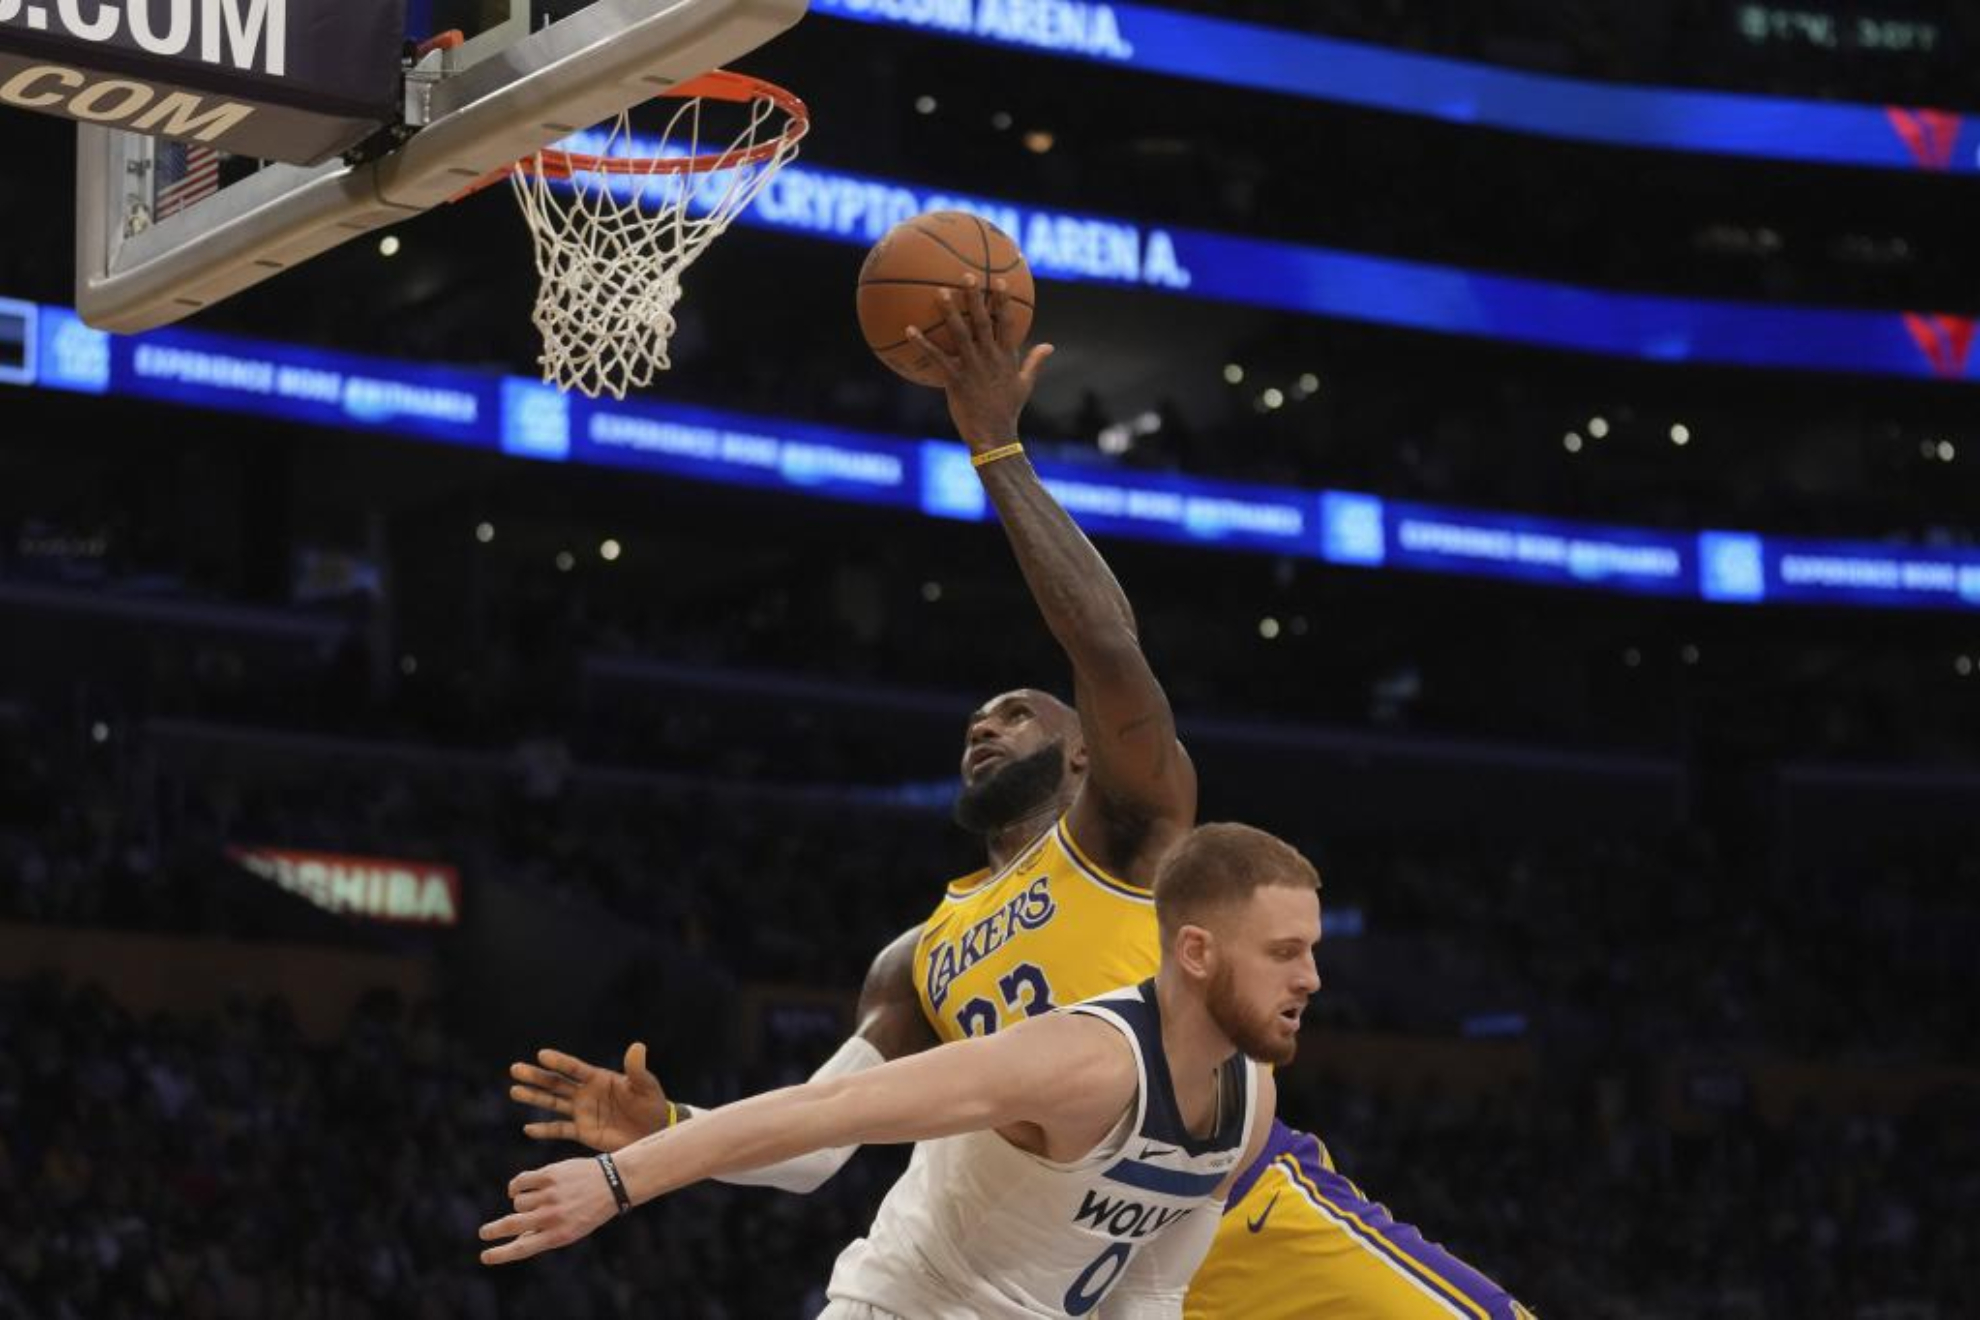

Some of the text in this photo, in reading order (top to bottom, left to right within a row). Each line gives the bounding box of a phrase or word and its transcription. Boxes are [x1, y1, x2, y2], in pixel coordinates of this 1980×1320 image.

[0, 65, 256, 142] COM
[928, 877, 1056, 1013] LAKERS
[1063, 1242, 1133, 1317] 0
